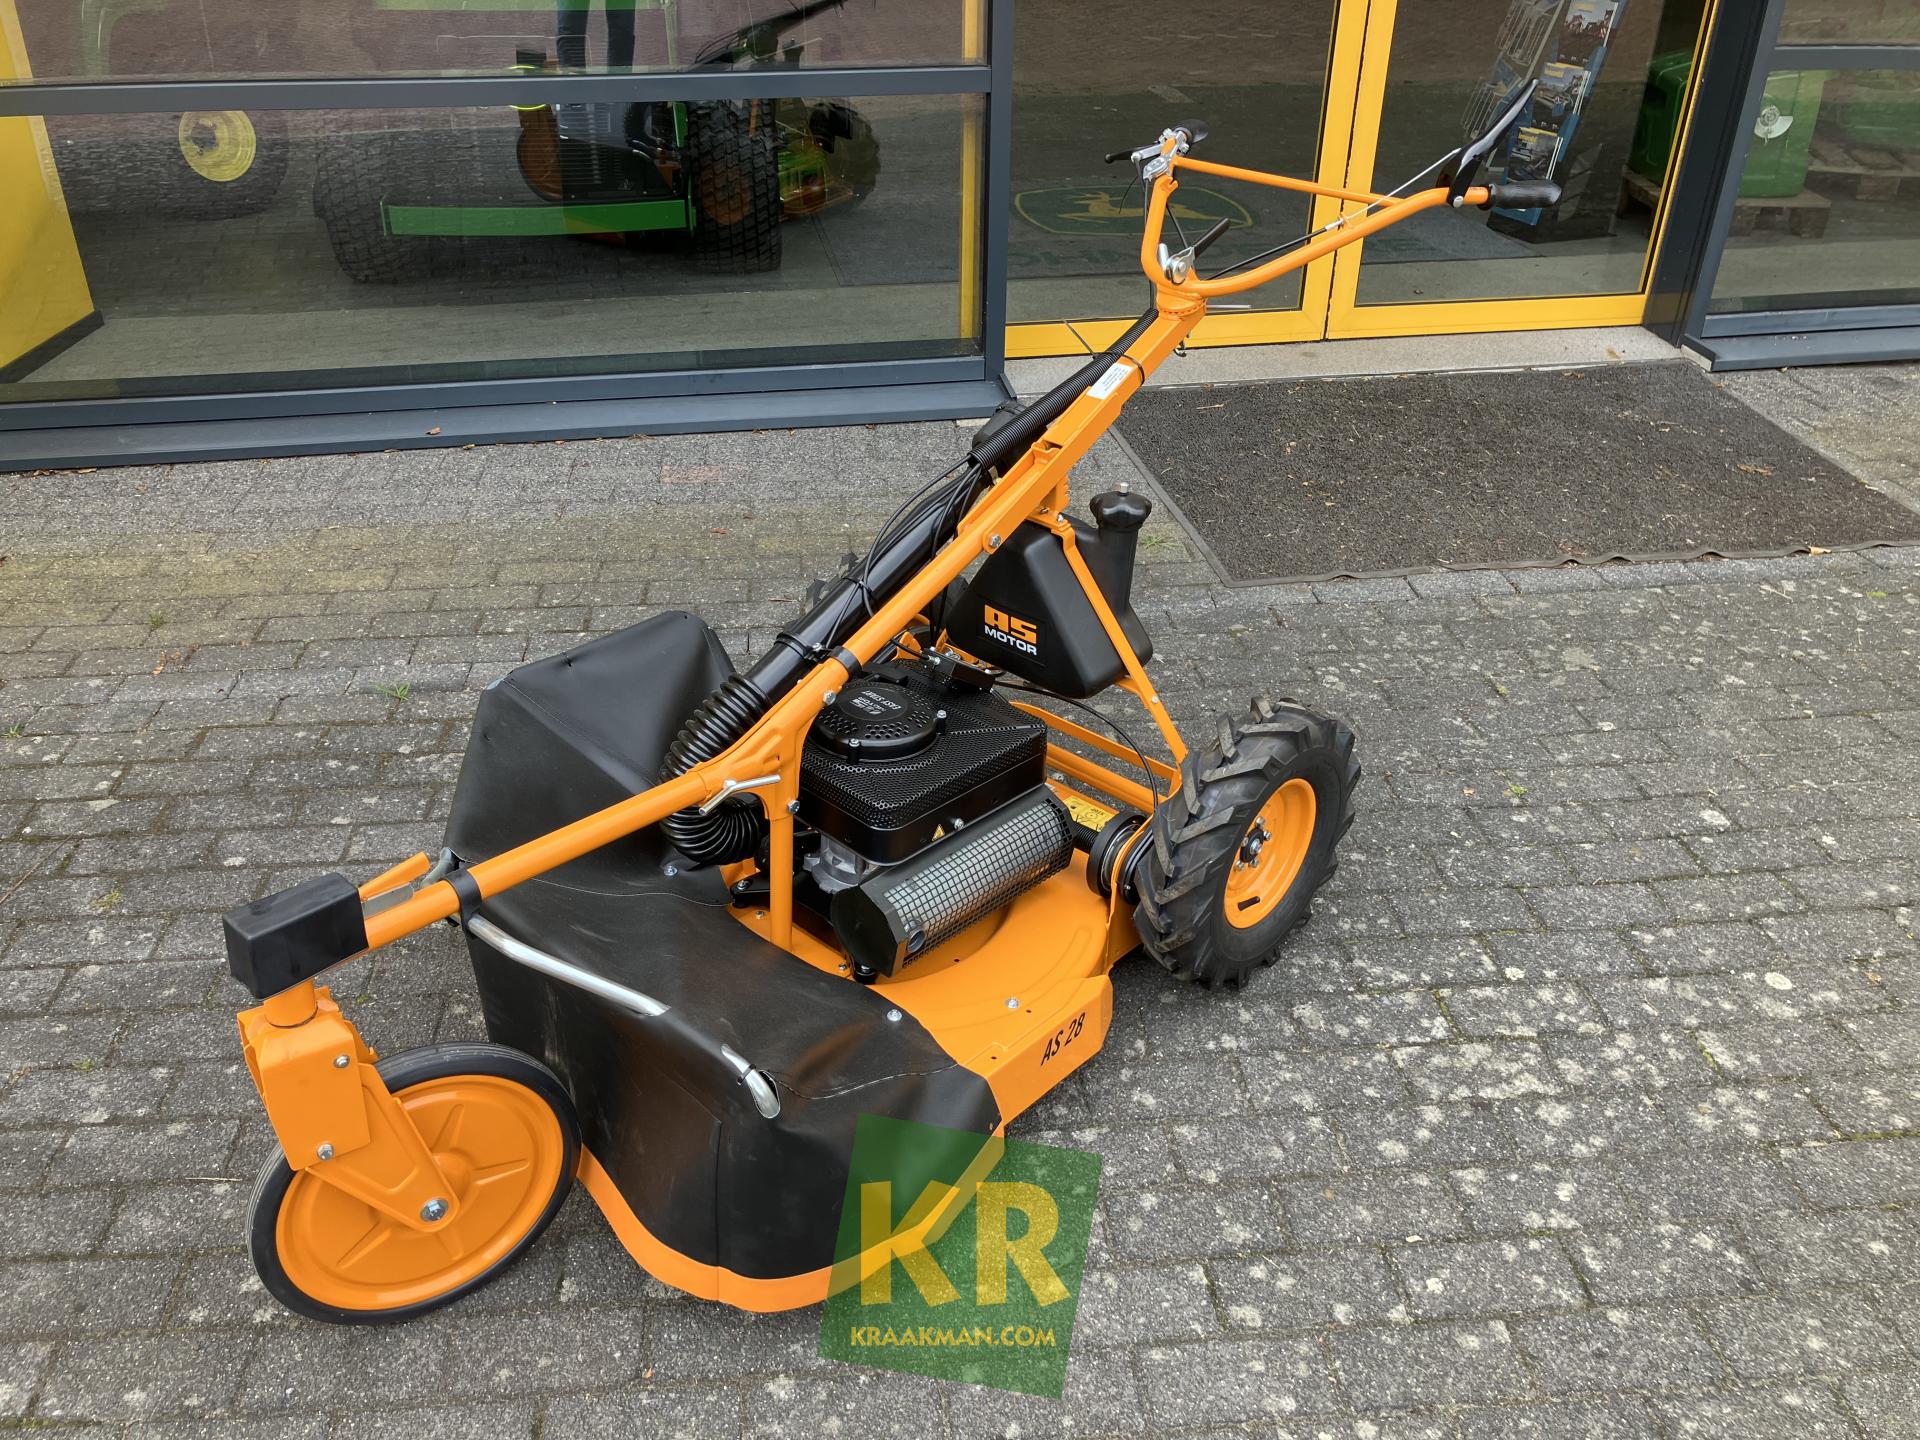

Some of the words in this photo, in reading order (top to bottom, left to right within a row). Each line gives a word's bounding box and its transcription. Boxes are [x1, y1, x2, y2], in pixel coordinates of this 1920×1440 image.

[984, 604, 1037, 645] AS
[984, 624, 1038, 656] MOTOR
[1040, 1029, 1064, 1067] AS
[1064, 1011, 1086, 1047] 28
